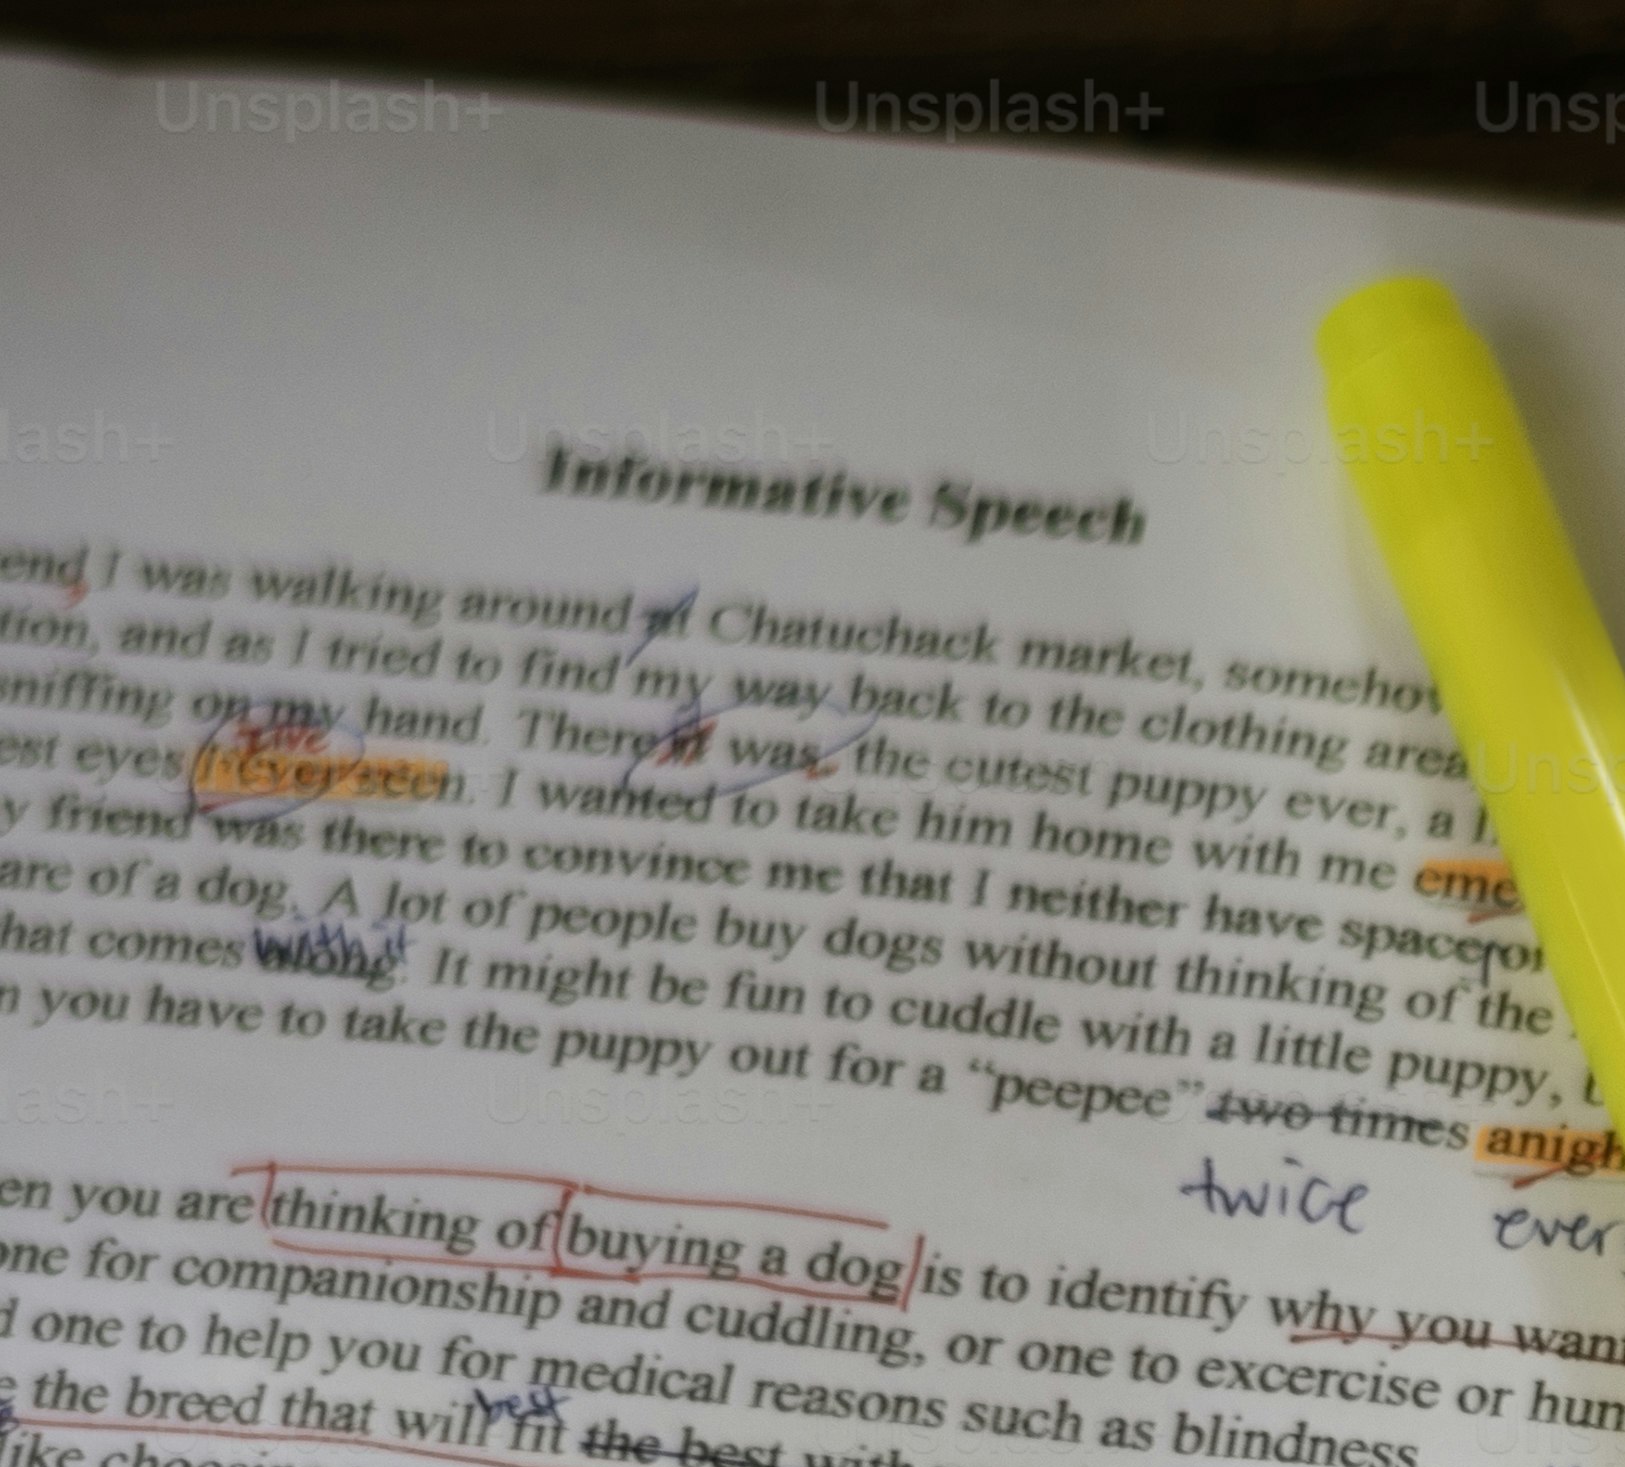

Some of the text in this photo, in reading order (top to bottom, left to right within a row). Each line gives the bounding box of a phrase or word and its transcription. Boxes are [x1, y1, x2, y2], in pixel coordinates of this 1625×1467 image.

[539, 444, 1148, 548] Informative Speech
[250, 565, 445, 625] walking
[461, 584, 631, 635] around
[711, 600, 998, 666] Chatuchack
[1019, 625, 1207, 692] market,
[324, 633, 1348, 775] tried find way back clothing
[366, 699, 1411, 842] hand. cutest puppy ever,
[47, 795, 1327, 946] friend convince neither have
[539, 776, 1303, 880] wanted take home with
[486, 948, 1567, 1110] might fun little puppy,
[530, 895, 1553, 1037] people buy dogs without thinking the
[553, 1014, 714, 1082] puppy
[728, 1031, 810, 1082] out
[828, 1039, 908, 1089] for
[72, 1174, 162, 1225] you
[268, 1187, 480, 1257] thinking
[564, 1207, 744, 1282] buying
[806, 1241, 904, 1303] dog
[1045, 1259, 1251, 1338] identify
[1272, 1289, 1377, 1339] why
[1395, 1305, 1495, 1355] you
[1182, 1154, 1372, 1236] twice
[170, 1245, 566, 1335] companionship
[577, 1286, 671, 1333] and
[685, 1296, 930, 1370] cuddling,
[1198, 1352, 1442, 1414] excercise
[205, 1312, 312, 1374] help
[328, 1328, 423, 1380] you
[530, 1342, 736, 1407] medical
[752, 1366, 947, 1433] reasons
[959, 1395, 1084, 1448] such
[125, 1377, 264, 1427] breed
[280, 1386, 377, 1433] that
